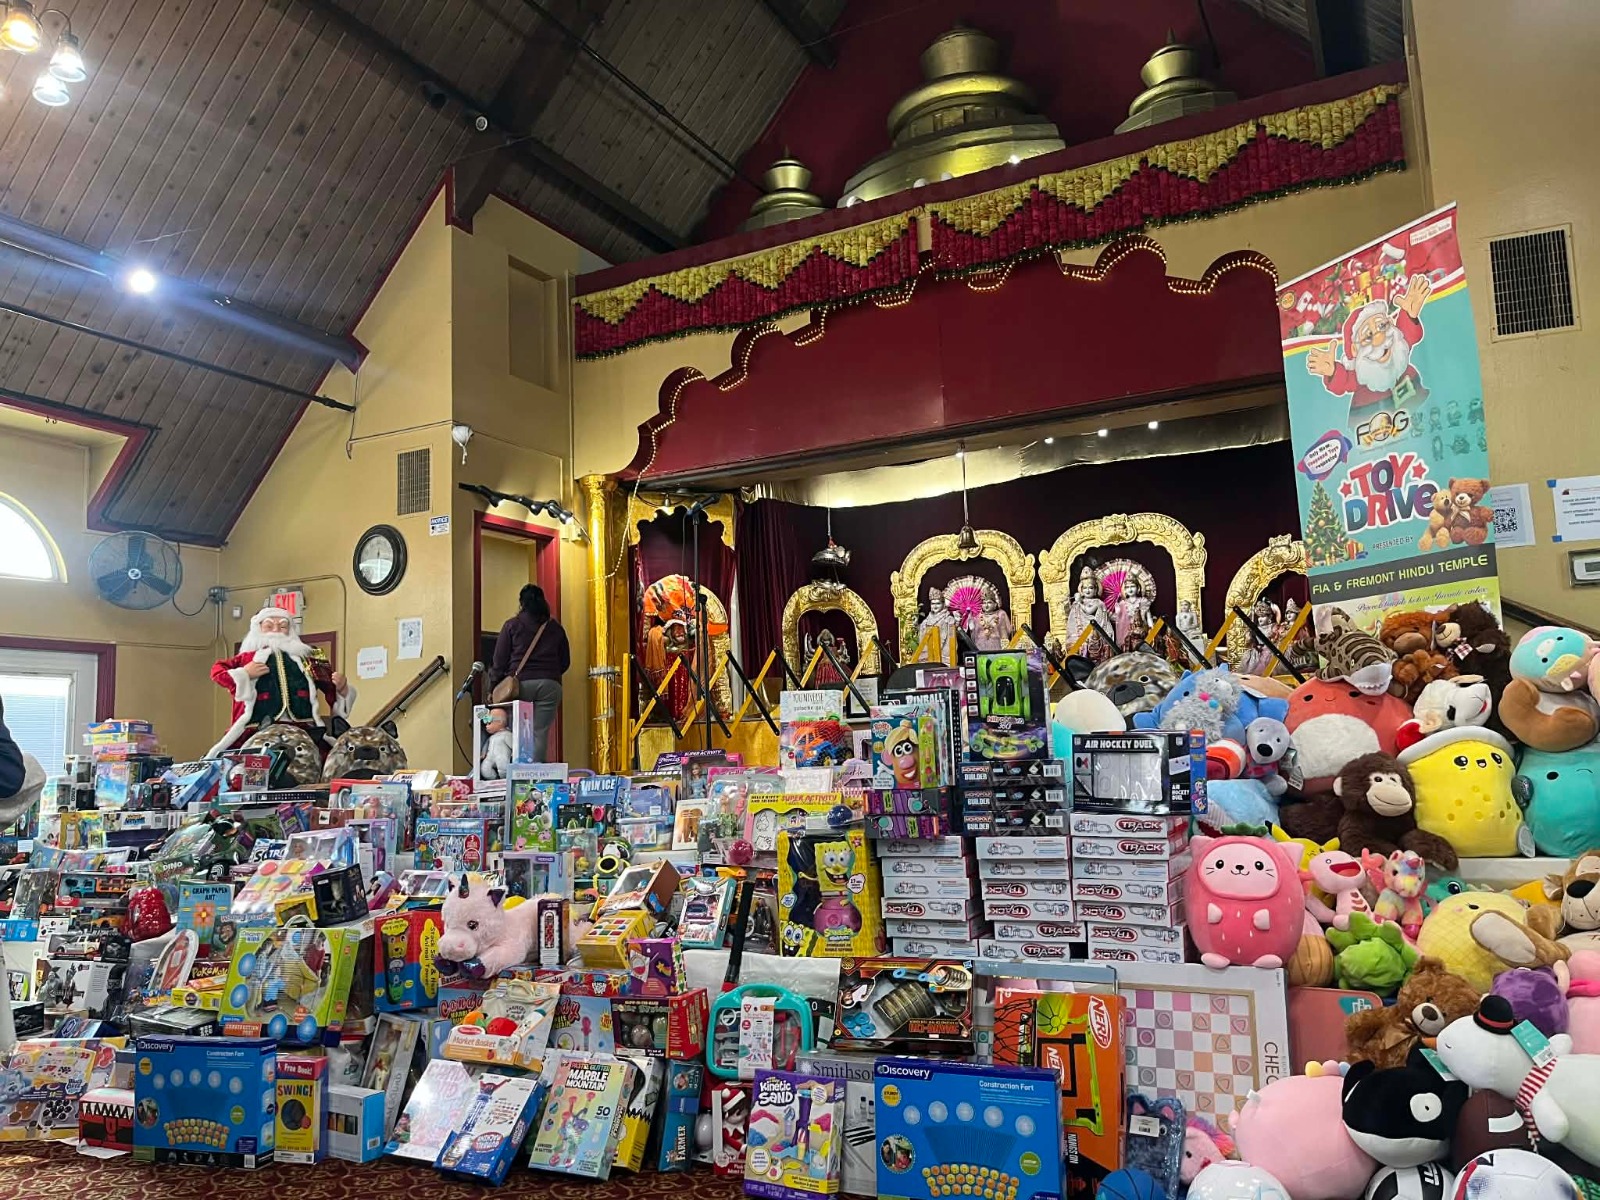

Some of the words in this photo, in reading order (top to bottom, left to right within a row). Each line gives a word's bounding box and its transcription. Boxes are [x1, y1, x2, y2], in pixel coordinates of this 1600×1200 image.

[1328, 446, 1339, 455] Toys
[1350, 454, 1415, 498] TOY
[1373, 538, 1405, 549] PRESENTED
[1312, 582, 1330, 595] FIA
[1334, 581, 1342, 591] &
[1347, 571, 1395, 589] FREMONT
[1399, 564, 1434, 580] HINDU
[1438, 554, 1488, 573] TEMPLE
[275, 592, 296, 615] EXIT
[906, 692, 944, 704] PINBALL
[1085, 740, 1098, 748] AIR
[1100, 740, 1132, 748] HOCKEY
[1133, 740, 1153, 748] DUEL
[601, 778, 616, 791] ICE
[1122, 821, 1160, 831] TRACK
[1123, 842, 1161, 852] TRACK
[163, 861, 182, 871] DINO
[987, 886, 1026, 896] TRACK
[1079, 887, 1121, 897] TRACK
[887, 904, 924, 914] TRACK
[990, 907, 1029, 917] TRACK
[1082, 907, 1124, 918] TRACK
[1042, 925, 1080, 936] TRACK
[1094, 930, 1136, 941] TRACK
[1028, 946, 1065, 956] TRACK
[812, 1001, 818, 1011] 0
[827, 1005, 832, 1014] 1
[1090, 997, 1109, 1046] NERF
[138, 1041, 173, 1052] Discovery
[453, 1036, 474, 1046] Market
[475, 1039, 496, 1048] Basket
[1263, 1041, 1280, 1085] CHEC
[285, 1063, 297, 1072] Free
[297, 1065, 313, 1076] Book!
[567, 1068, 608, 1082] MARBLE
[881, 1064, 929, 1080] Discovery
[565, 1078, 605, 1091] MOUNTAIN
[760, 1080, 790, 1091] Kinetic
[979, 1080, 1019, 1090] Construction
[1020, 1083, 1034, 1091] Fort
[278, 1084, 313, 1097] SWING!
[596, 1105, 610, 1117] 50
[677, 1125, 686, 1160] FARMER
[1068, 1134, 1078, 1154] HANGS
[1069, 1154, 1079, 1164] ON
